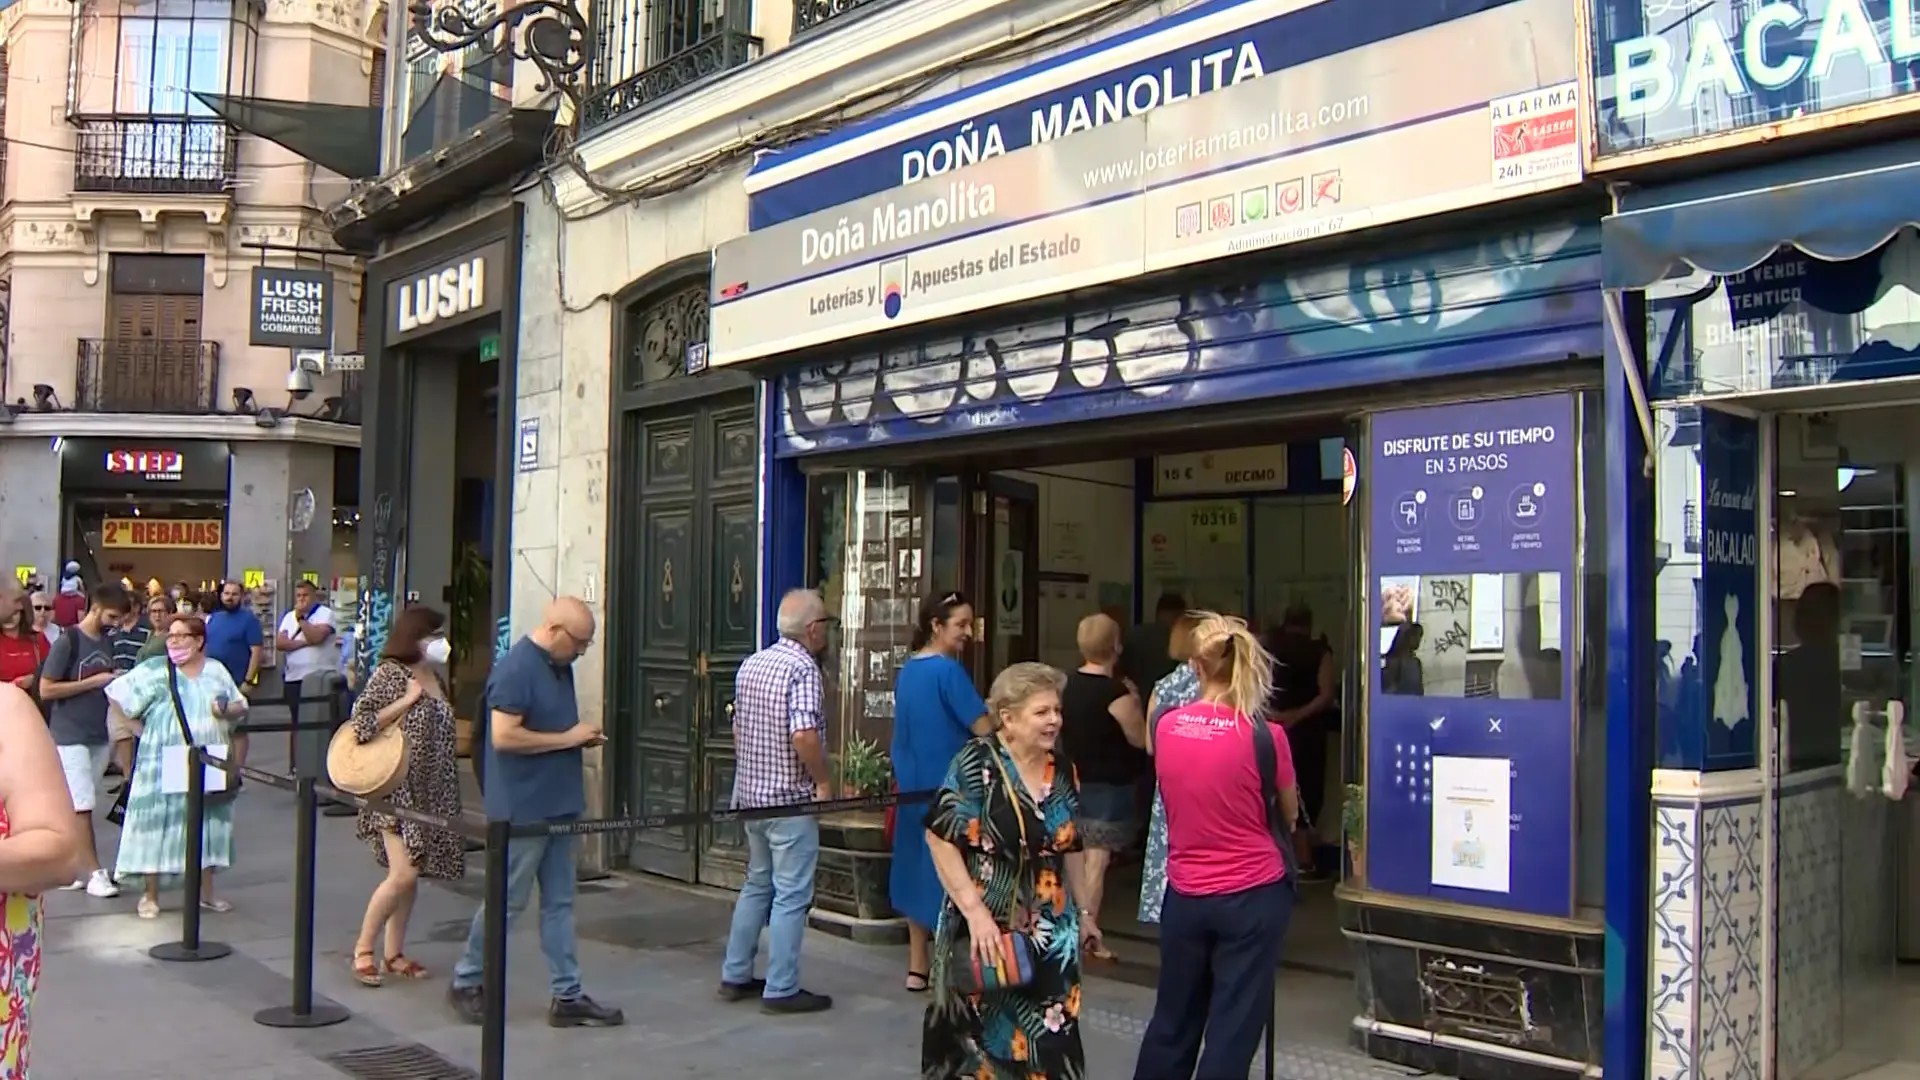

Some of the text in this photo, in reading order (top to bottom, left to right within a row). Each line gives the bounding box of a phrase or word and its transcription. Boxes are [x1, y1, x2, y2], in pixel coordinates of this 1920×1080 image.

[903, 41, 1265, 185] DOÑA MANOLITA
[1492, 88, 1576, 119] ALARMA
[1082, 95, 1369, 189] www.loteriamanolita.com
[1498, 163, 1523, 180] 24h
[801, 181, 996, 266] Doña Manolita
[1228, 223, 1310, 252] Administración
[1328, 217, 1343, 231] 67
[809, 233, 1081, 316] Loterías y Apuestas del Estado
[1753, 261, 1808, 283] VENDE
[262, 279, 323, 299] LUSH
[399, 257, 484, 332] LUSH
[261, 297, 322, 314] FRESH
[260, 322, 322, 335] COSMETICS
[261, 312, 322, 325] HANDMADE
[1383, 426, 1555, 457] DISFRUTE DE SU TIEMPO
[111, 449, 178, 473] STEP
[1425, 453, 1508, 475] EN 3 PASOS
[1225, 468, 1275, 484] DECIMO
[132, 522, 219, 545] REBAJAS
[1706, 528, 1756, 567] BACALAO
